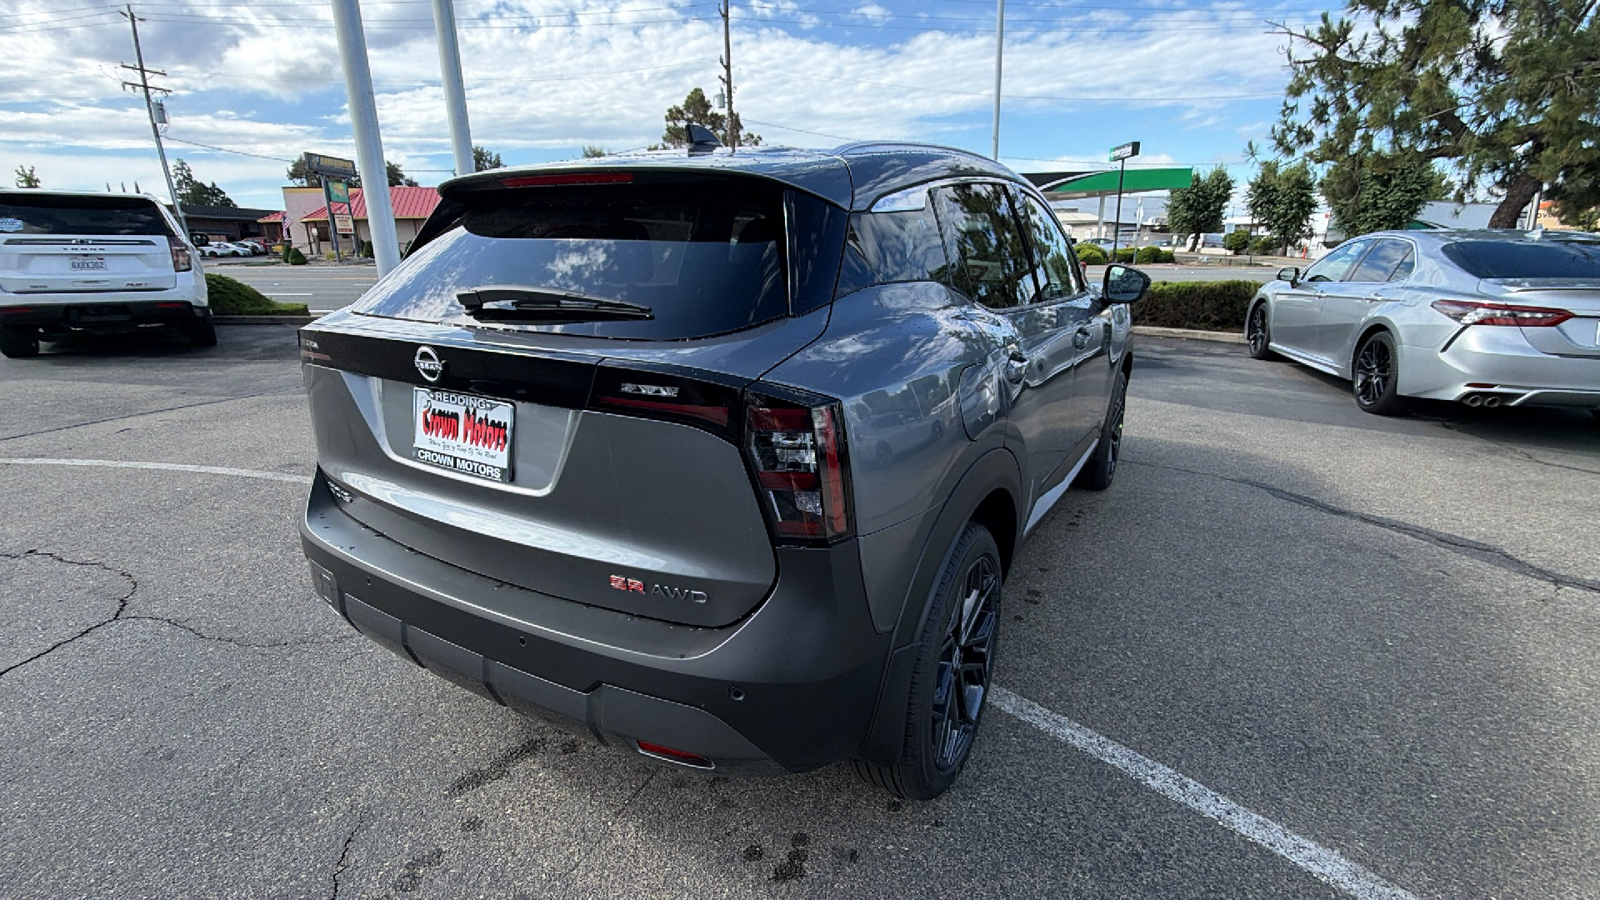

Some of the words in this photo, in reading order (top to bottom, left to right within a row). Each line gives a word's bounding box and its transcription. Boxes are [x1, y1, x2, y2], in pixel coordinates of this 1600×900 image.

[414, 360, 442, 371] NISSAN
[435, 392, 486, 409] REDDING
[422, 407, 459, 442] Crown
[463, 409, 508, 452] Motors
[418, 449, 454, 467] CROWN
[456, 458, 501, 478] MOTORS
[609, 574, 646, 595] SR
[651, 584, 709, 604] AWD
